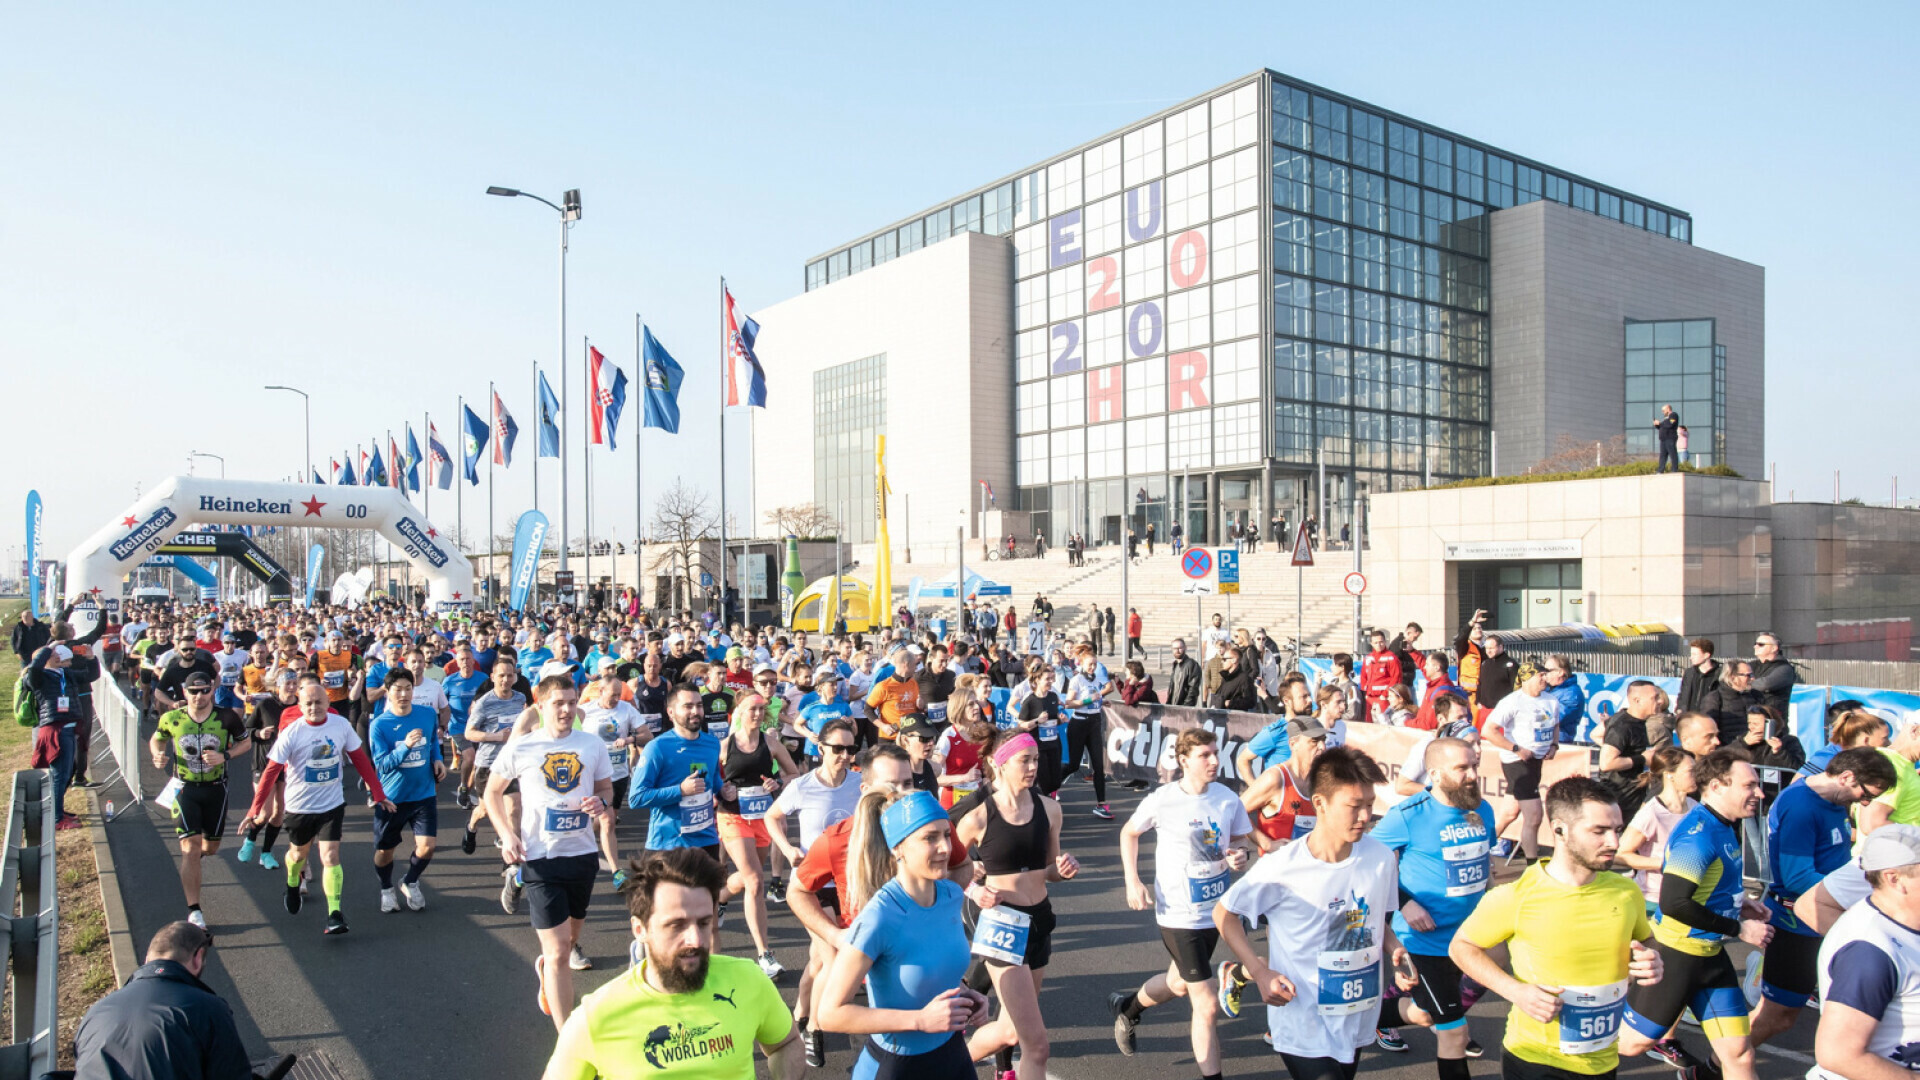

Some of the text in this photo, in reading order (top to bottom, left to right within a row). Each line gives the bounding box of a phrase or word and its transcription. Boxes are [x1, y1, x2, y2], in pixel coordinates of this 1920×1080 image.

[199, 495, 292, 514] Heineken
[113, 512, 173, 558] Heineken
[400, 520, 443, 564] Heineken
[518, 521, 546, 589] DECATHLON
[1221, 552, 1231, 567] P
[1030, 627, 1044, 651] 21
[317, 771, 330, 781] 63
[689, 808, 709, 824] 255
[748, 800, 768, 812] 447
[556, 816, 581, 830] 254
[1440, 824, 1487, 844] sljeme
[1458, 864, 1483, 884] 525
[1201, 881, 1225, 899] 330
[985, 928, 1016, 949] 442
[1342, 979, 1363, 1000] 85
[1580, 1012, 1615, 1038] 561
